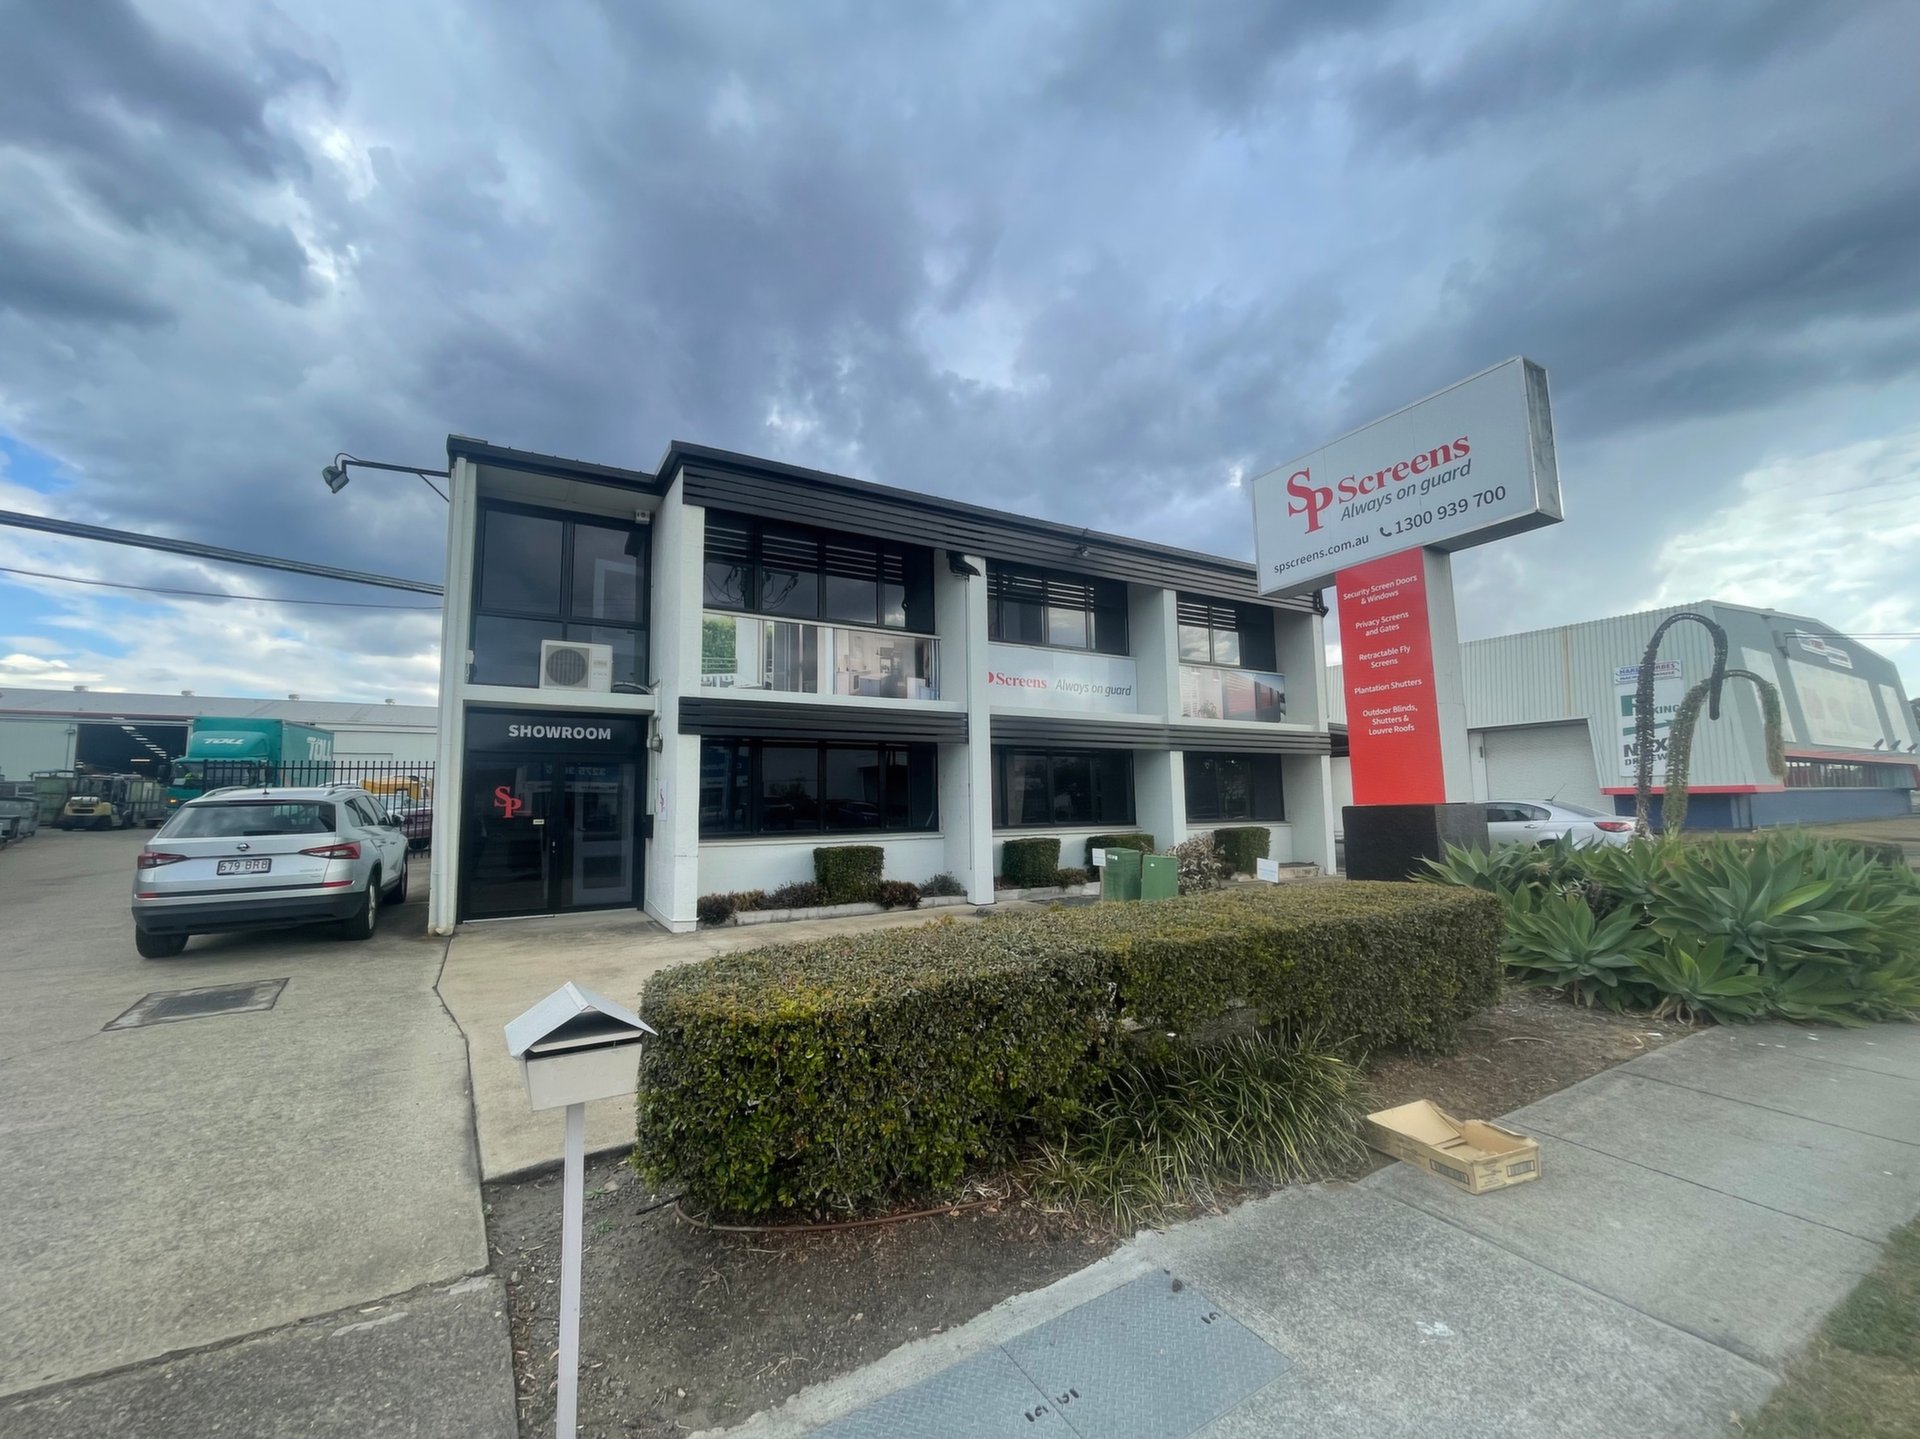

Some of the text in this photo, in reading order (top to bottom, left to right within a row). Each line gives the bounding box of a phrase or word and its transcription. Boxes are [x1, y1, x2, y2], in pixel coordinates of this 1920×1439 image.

[1287, 435, 1471, 535] SP Screens
[1341, 458, 1472, 521] Always on guard
[1395, 485, 1506, 535] 1300 939 700
[1273, 535, 1370, 574] spscreens.com.au
[1343, 574, 1418, 601] Security Screen Doors
[1360, 590, 1399, 605] & Windows
[1355, 611, 1409, 630] Privacy Screens
[1365, 623, 1400, 637] and Gates
[1359, 645, 1411, 661] Retractable Fly
[1370, 657, 1398, 669] Screens
[996, 672, 1047, 689] Screens
[1056, 679, 1089, 695] Always
[1091, 684, 1103, 694] on
[1105, 685, 1132, 698] guard
[1354, 678, 1422, 695] Plantation Shutters
[1362, 703, 1418, 717] Outdoor Blinds,
[1372, 714, 1409, 726] Shutters &
[508, 724, 611, 740] SHOWROOM
[1369, 724, 1415, 735] Louvre Roofs
[306, 736, 332, 761] TOLL
[494, 785, 522, 819] SP
[220, 861, 240, 872] 679
